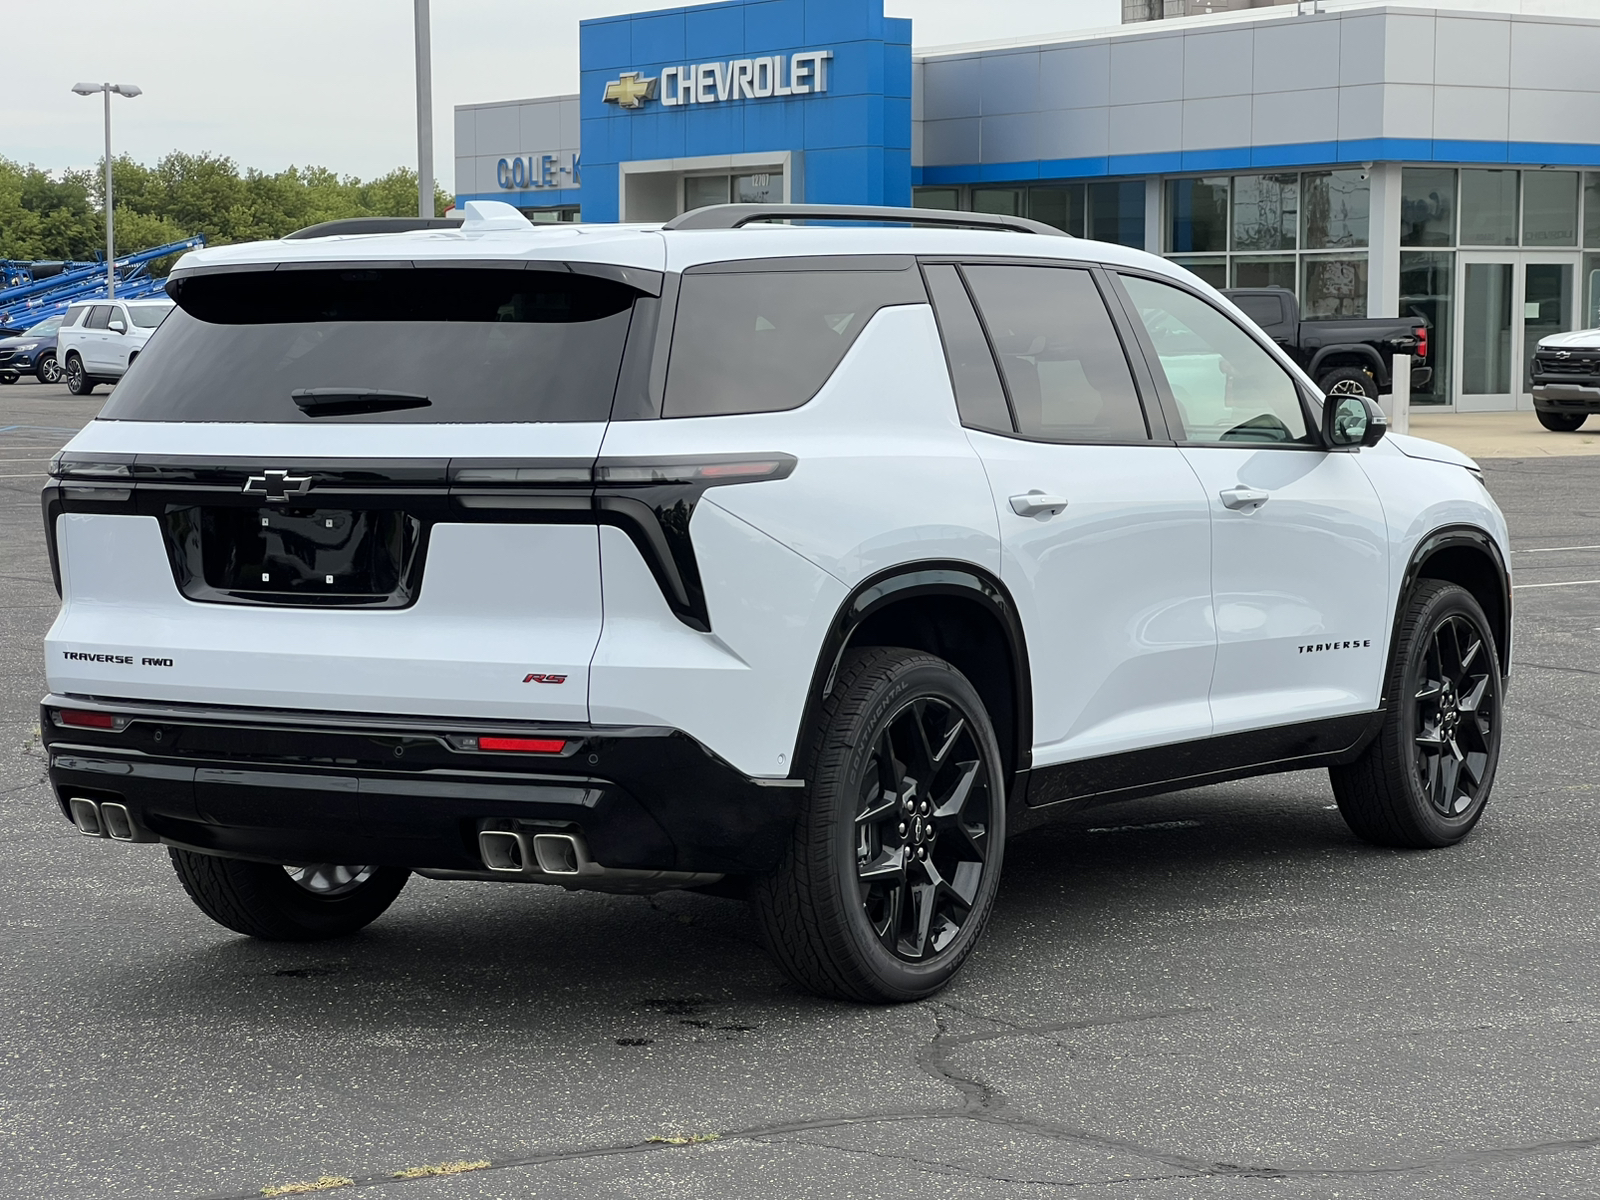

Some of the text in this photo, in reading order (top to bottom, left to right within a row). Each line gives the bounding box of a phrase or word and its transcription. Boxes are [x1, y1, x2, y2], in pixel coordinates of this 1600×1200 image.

[661, 50, 832, 106] CHEVROLET
[752, 174, 769, 187] 12707
[1298, 640, 1370, 654] TRAVERSE
[63, 651, 174, 667] TRAVERSE AWD
[522, 673, 568, 684] RS
[849, 681, 909, 786] CONTINENTAL
